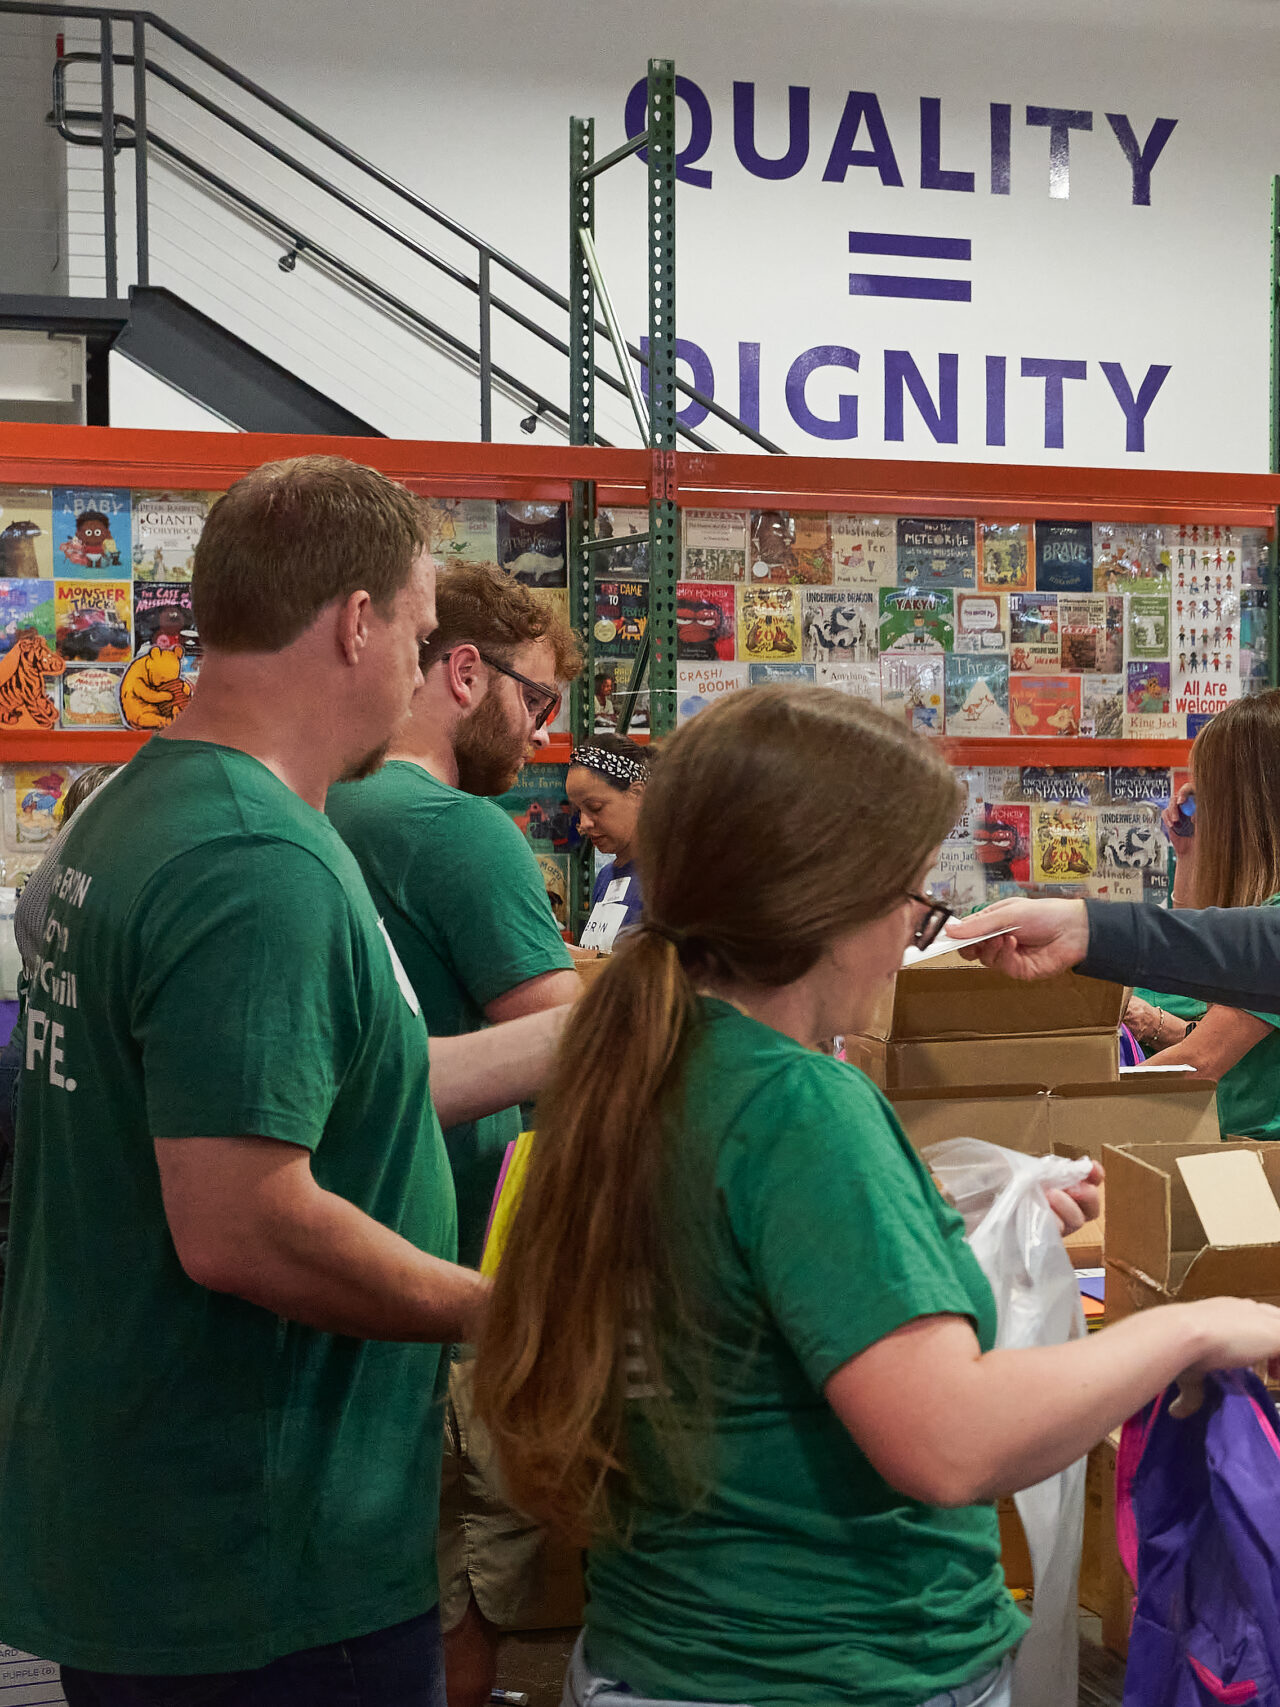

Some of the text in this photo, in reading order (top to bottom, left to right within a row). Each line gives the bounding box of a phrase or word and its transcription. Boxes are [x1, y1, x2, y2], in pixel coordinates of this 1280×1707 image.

[624, 74, 1179, 206] QUALITY
[640, 336, 1173, 453] DIGNITY
[74, 498, 124, 516] BABY
[145, 511, 195, 526] GIANT
[1042, 542, 1089, 563] BRAVE
[58, 587, 126, 602] MONSTER
[156, 588, 178, 598] CASE
[620, 583, 643, 596] CAME
[608, 595, 619, 606] TO
[806, 592, 846, 603] UNDERWEAR
[952, 657, 1001, 675] Three
[680, 670, 723, 682] CRASH!
[698, 680, 739, 693] BOOM!
[1184, 681, 1227, 696] All Are
[1130, 716, 1178, 730] King Jack
[1127, 785, 1168, 800] SPACE
